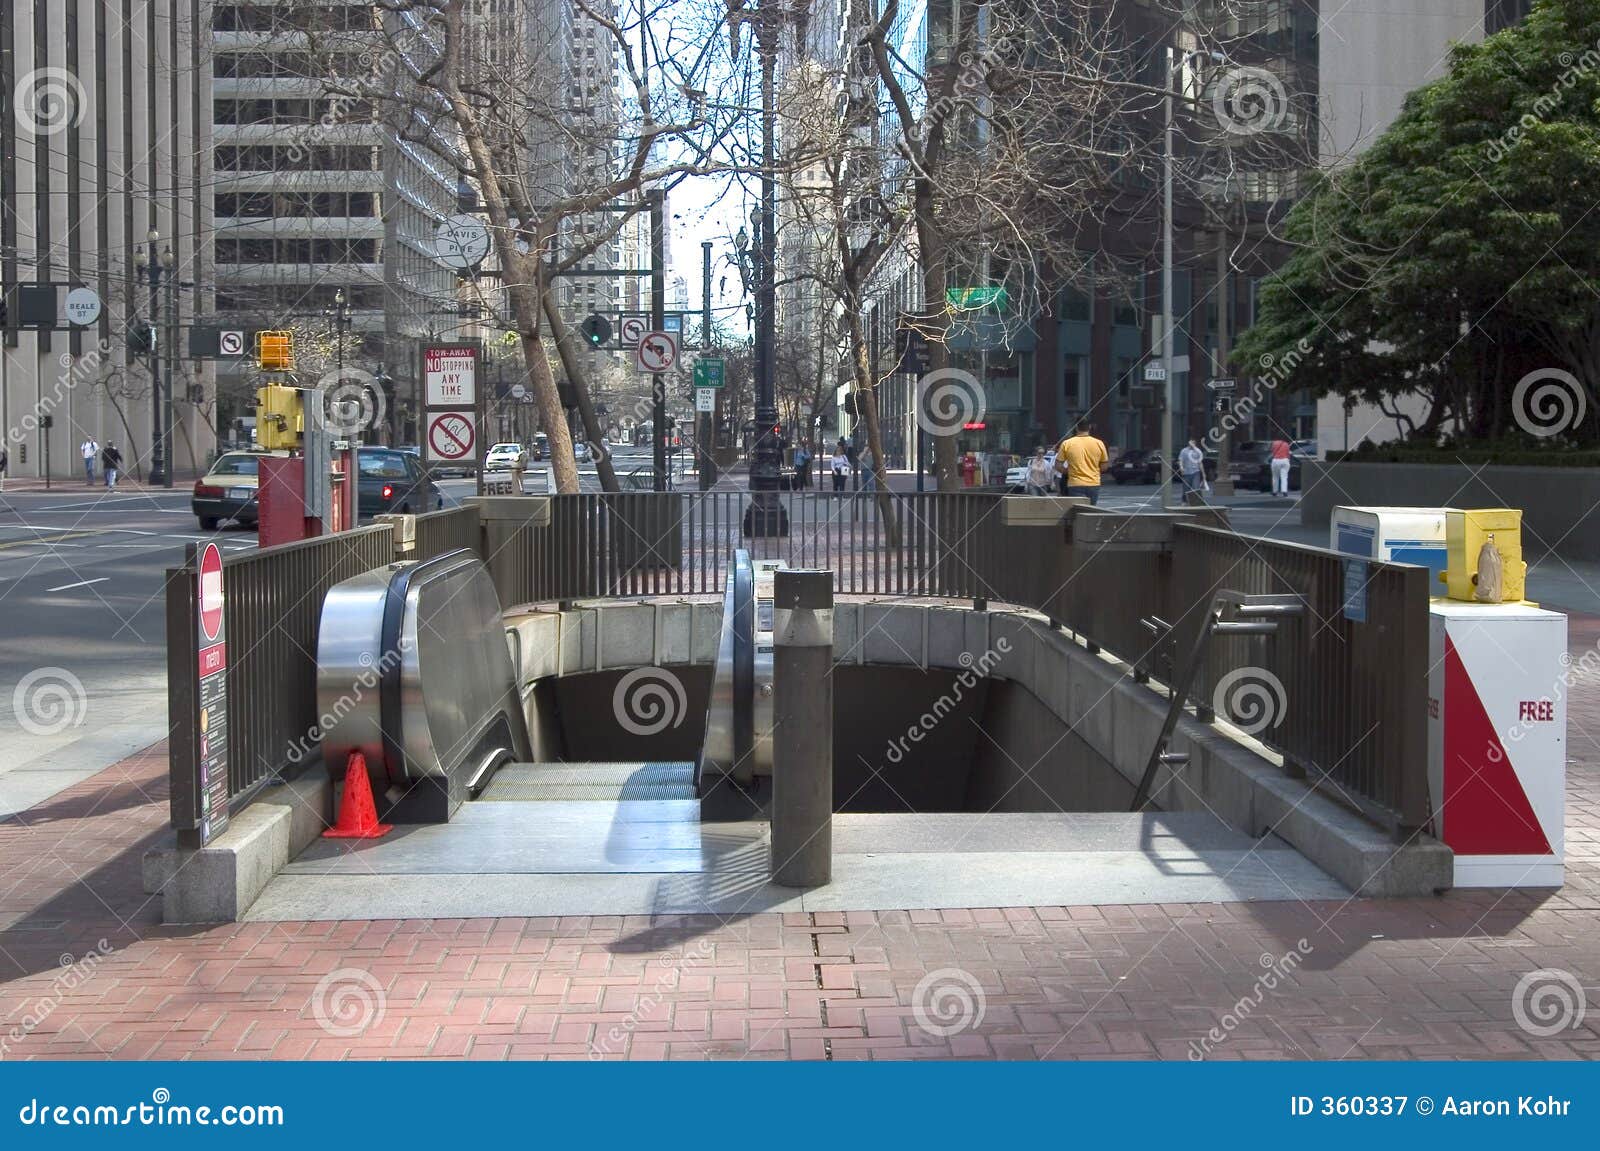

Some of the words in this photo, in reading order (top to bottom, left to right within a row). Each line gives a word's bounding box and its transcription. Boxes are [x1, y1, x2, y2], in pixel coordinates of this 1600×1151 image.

[447, 230, 477, 238] DAVIS
[430, 349, 472, 357] TOW-AWAY
[427, 358, 440, 371] NO
[441, 360, 474, 371] STOPPING
[441, 374, 461, 384] ANY
[441, 385, 462, 395] TIME
[1519, 701, 1554, 721] FREE
